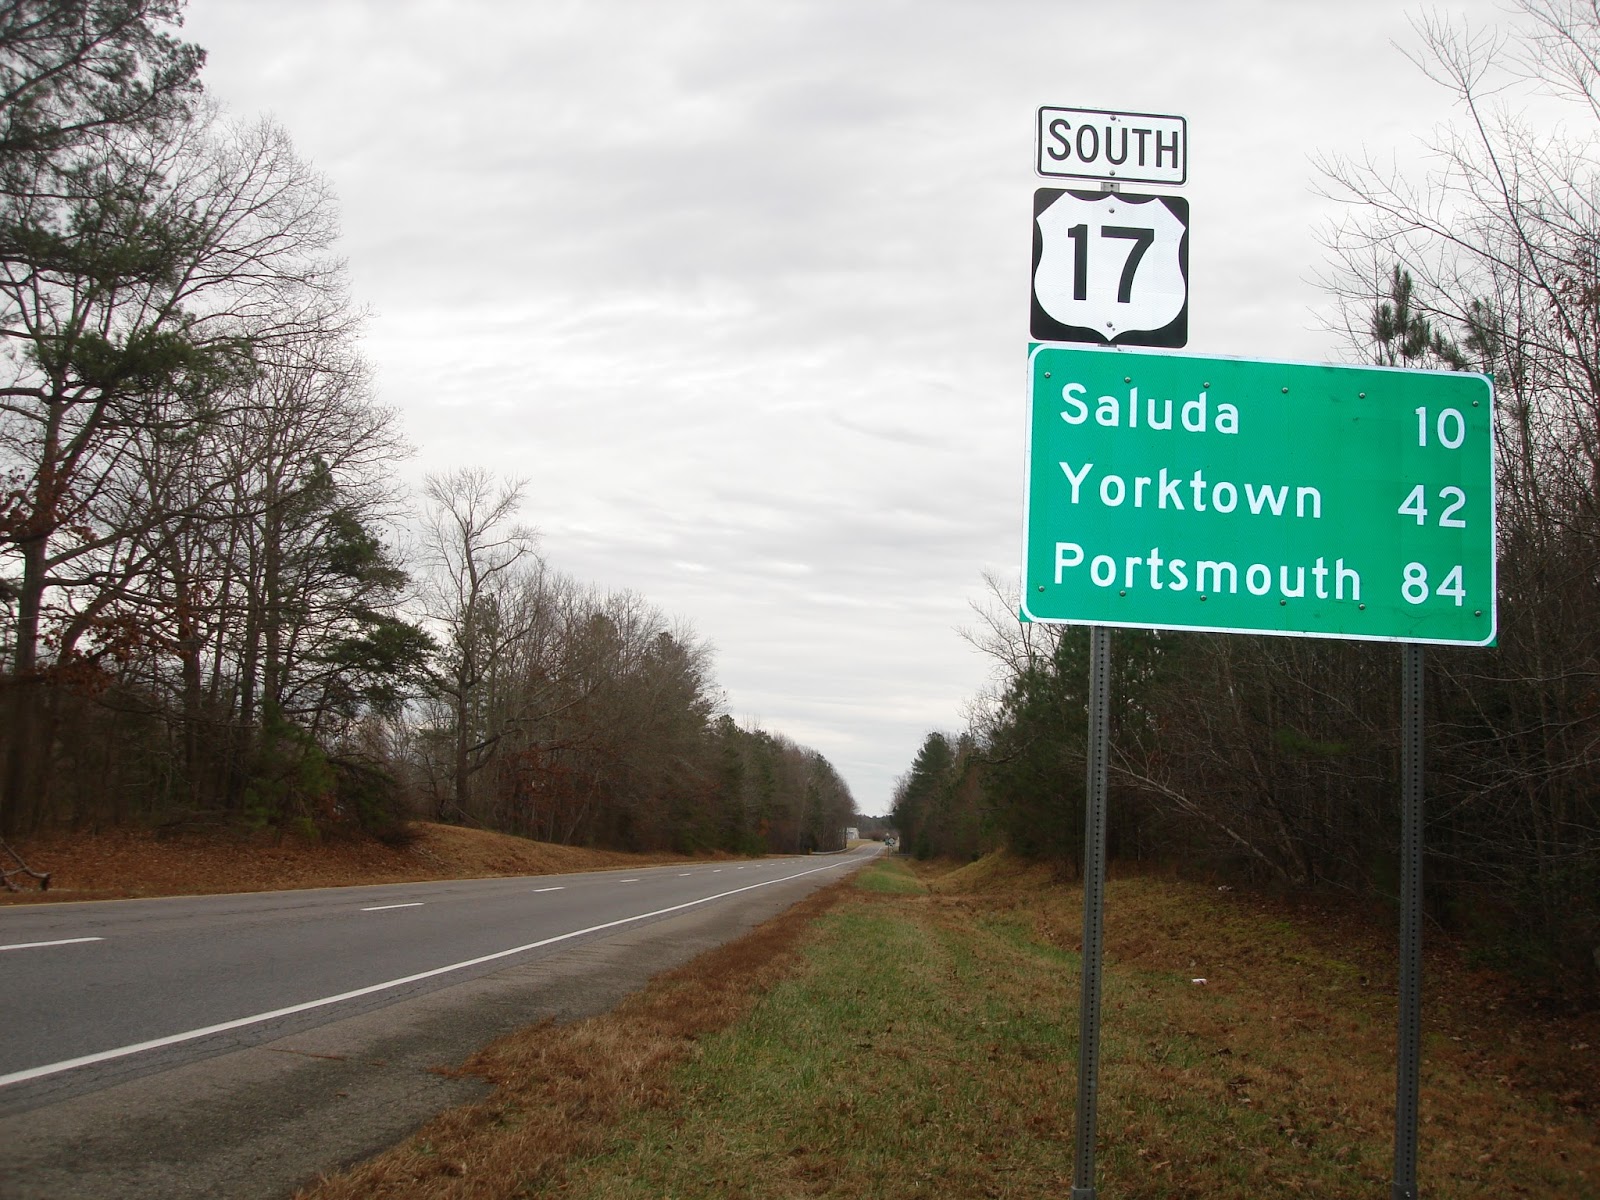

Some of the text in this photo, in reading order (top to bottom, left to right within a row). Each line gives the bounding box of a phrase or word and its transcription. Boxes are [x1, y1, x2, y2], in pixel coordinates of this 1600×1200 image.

[1047, 118, 1179, 169] SOUTH
[1066, 223, 1155, 304] 17
[1060, 382, 1466, 450] Saluda 10
[1059, 461, 1467, 528] Yorktown 42
[1054, 542, 1467, 607] Portsmouth 84
